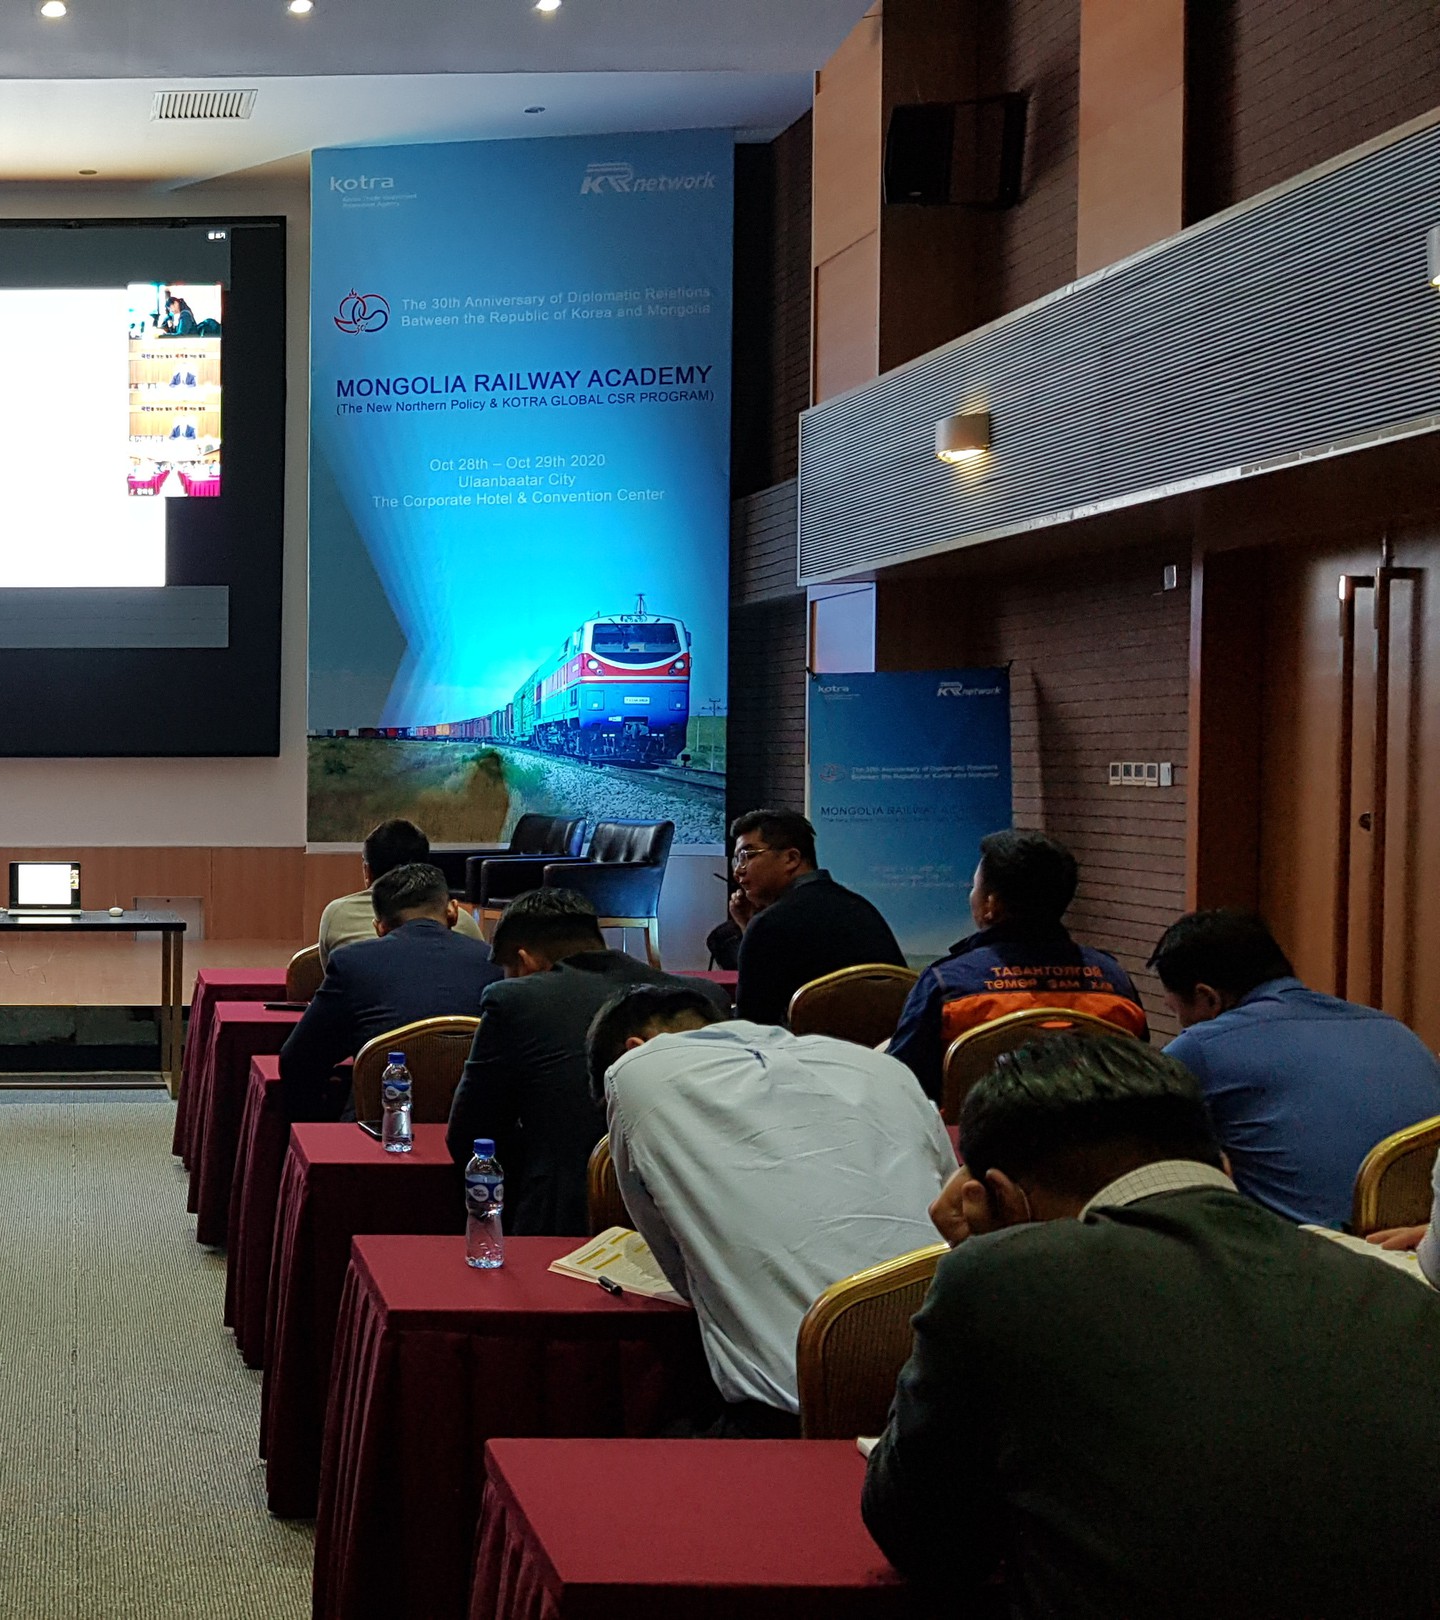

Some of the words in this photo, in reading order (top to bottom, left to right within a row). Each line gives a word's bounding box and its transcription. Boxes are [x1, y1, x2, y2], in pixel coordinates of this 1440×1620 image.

[330, 175, 394, 193] kotra
[401, 298, 426, 311] The
[432, 297, 460, 309] 30th
[464, 295, 546, 308] Anniversary
[550, 293, 563, 304] of
[568, 289, 641, 304] Diplomatic
[401, 315, 459, 327] Between
[464, 313, 485, 324] the
[490, 311, 549, 325] Republic
[554, 309, 567, 321] of
[571, 307, 612, 320] Korea
[617, 305, 643, 317] and
[336, 375, 467, 398] MONGOLIA
[474, 370, 581, 392] RAILWAY
[587, 365, 712, 388] ACADEMY
[336, 403, 363, 416] (The
[366, 402, 392, 413] New
[396, 401, 447, 412] Northern
[451, 399, 486, 412] Policy
[489, 398, 498, 408] &
[502, 396, 548, 408] KOTRA
[550, 394, 604, 406] GLOBAL
[607, 393, 636, 404] CSR
[640, 390, 714, 403] PROGRAM)
[429, 459, 454, 471] Oct
[458, 458, 488, 470] 28th
[506, 456, 531, 469] Oct
[535, 456, 566, 468] 29th
[570, 454, 606, 467] 2020
[458, 474, 544, 488] Ulaanbaatar
[548, 472, 576, 488] City
[372, 495, 399, 508] The
[403, 495, 472, 509] Corporate
[476, 492, 512, 505] Hotel
[517, 491, 527, 504] &
[532, 490, 612, 503] Convention
[617, 488, 665, 501] Center
[821, 806, 884, 816] MONGOLIA
